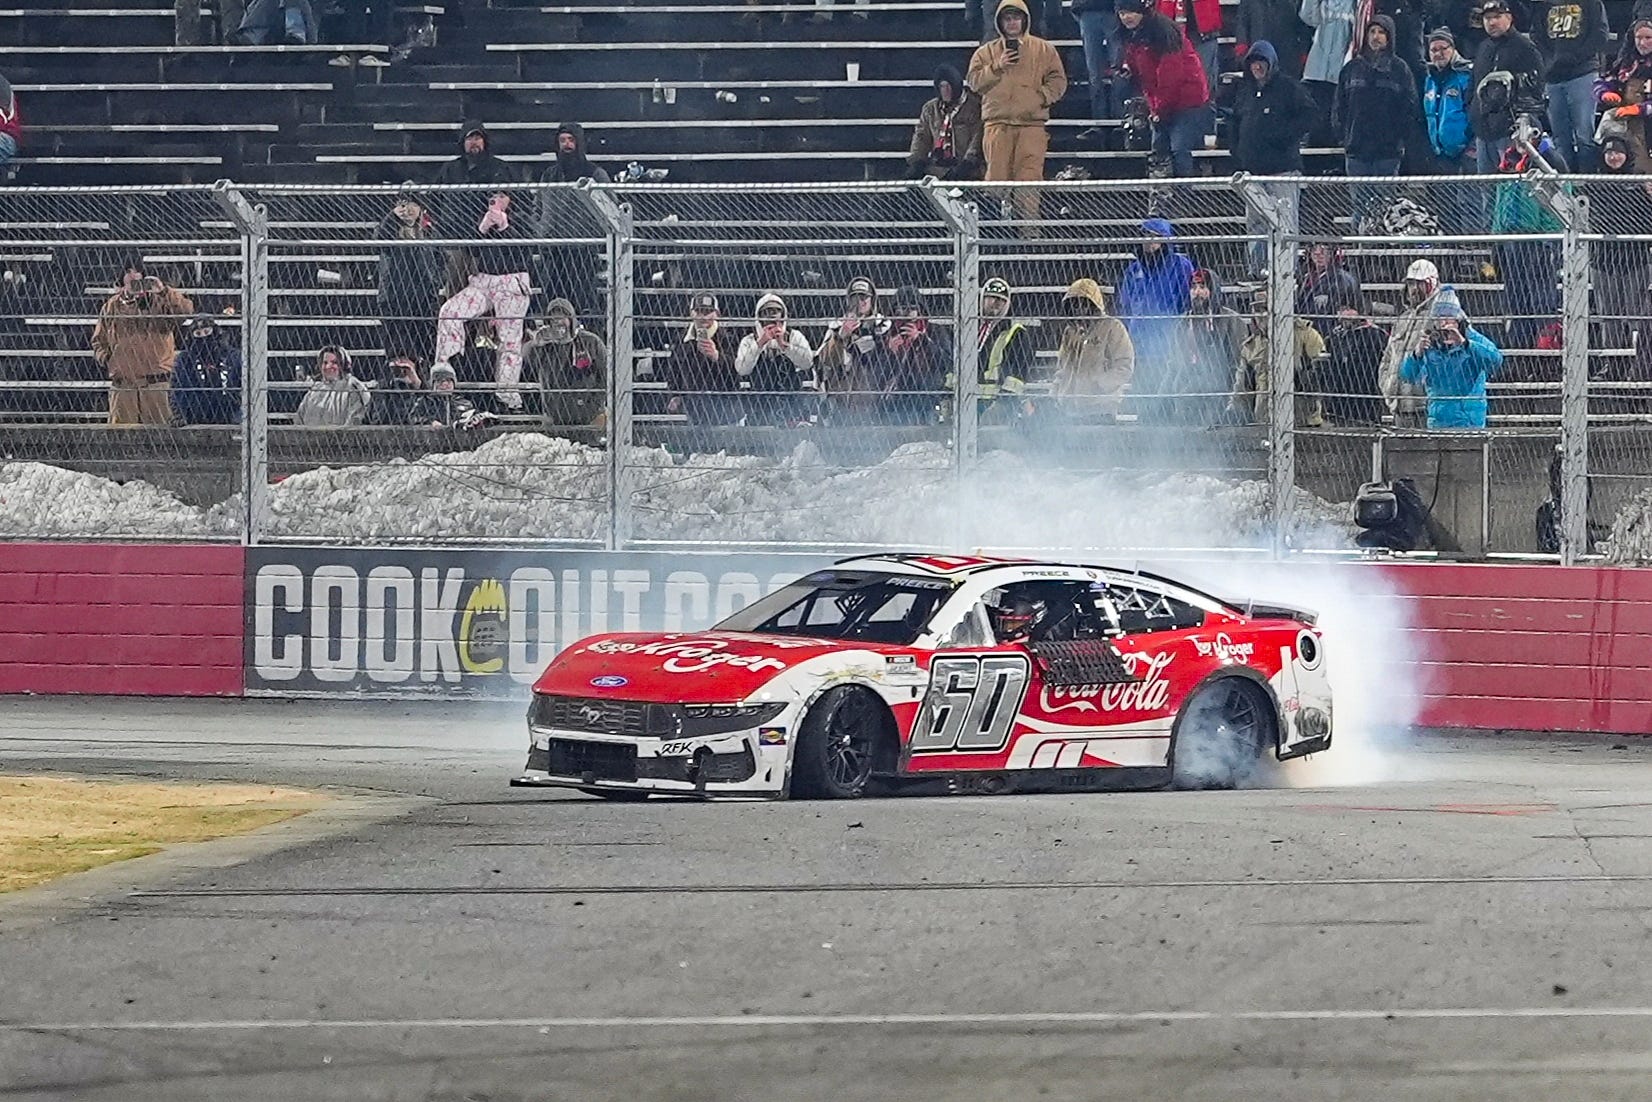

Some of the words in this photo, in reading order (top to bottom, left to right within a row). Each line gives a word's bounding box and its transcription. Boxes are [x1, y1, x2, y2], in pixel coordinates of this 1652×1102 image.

[1552, 15, 1573, 31] 20
[885, 577, 944, 589] PREECE
[254, 564, 464, 683] COOK
[508, 566, 650, 684] OUT
[637, 640, 786, 673] Kroger
[1213, 631, 1254, 665] Kroger
[1040, 651, 1177, 713] CocaCola
[909, 654, 1030, 752] 60
[661, 742, 693, 754] RFK
